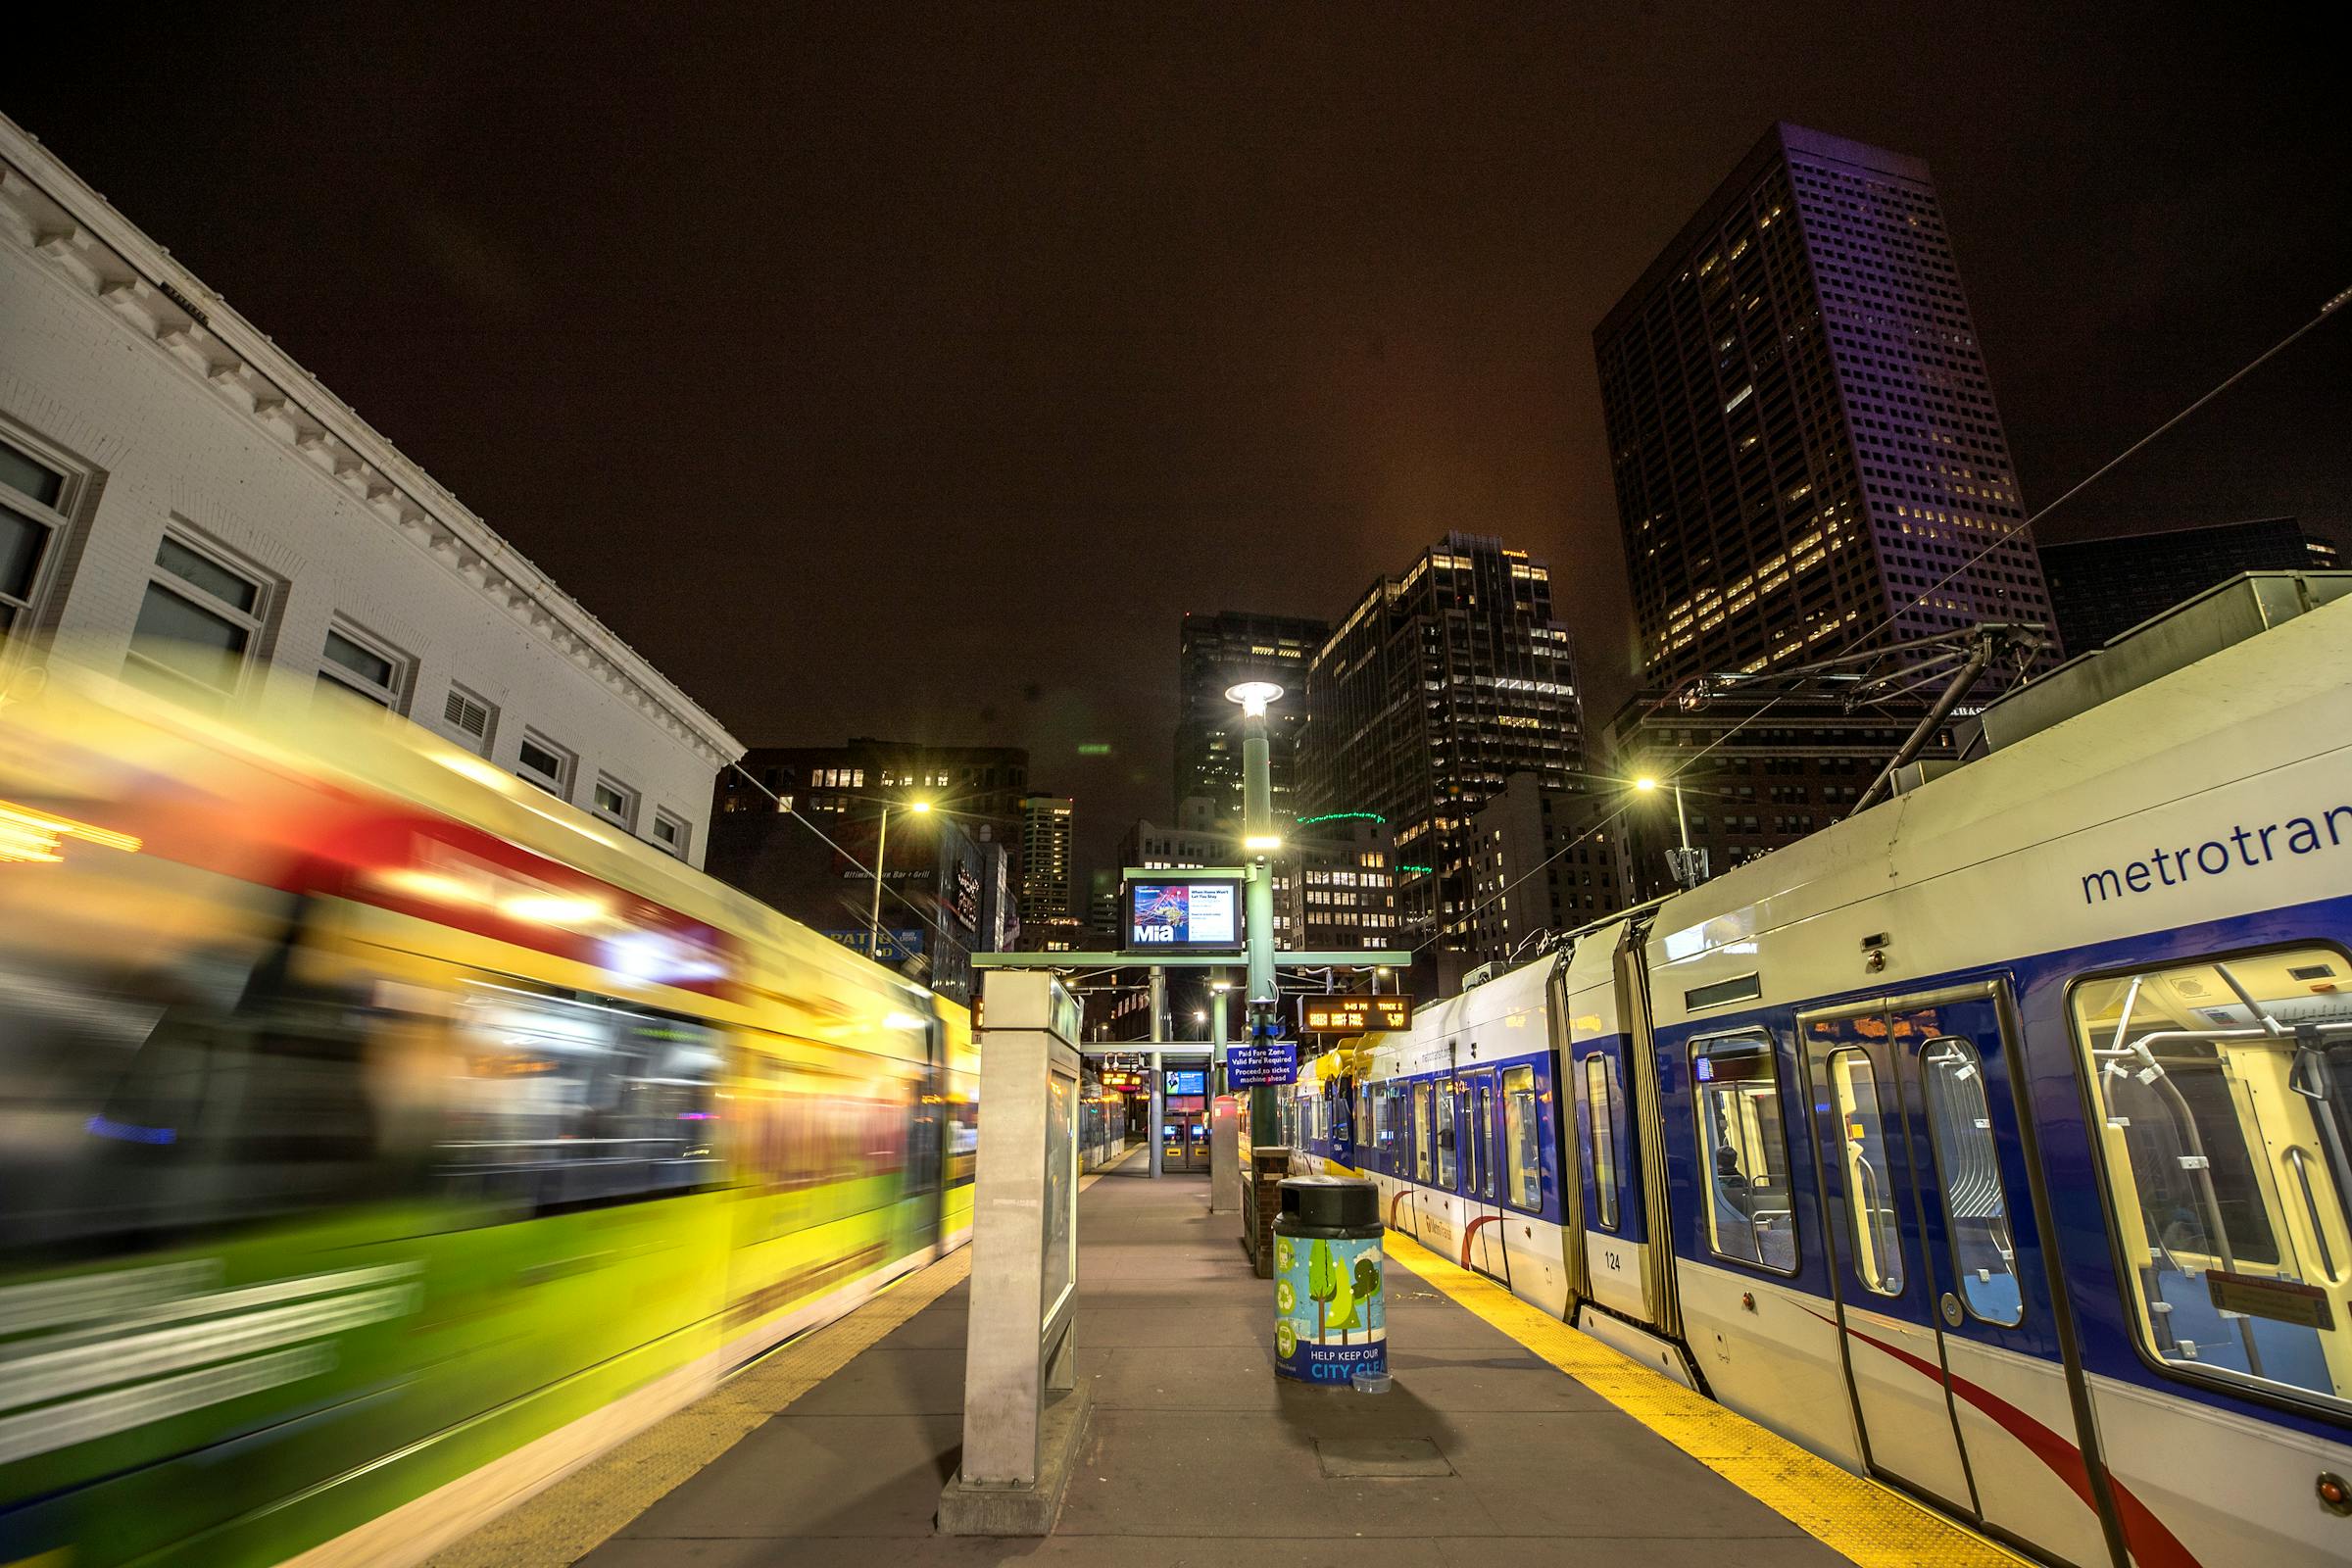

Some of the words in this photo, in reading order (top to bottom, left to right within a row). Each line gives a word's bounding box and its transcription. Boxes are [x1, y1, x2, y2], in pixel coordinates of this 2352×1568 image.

[2082, 806, 2352, 905] metrotran
[830, 933, 893, 945] PATO
[1134, 925, 1174, 942] Mia
[1264, 1056, 1292, 1065] Required
[1604, 1250, 1621, 1272] 124
[1311, 1351, 1335, 1360] HELP
[1339, 1350, 1360, 1360] KEEP
[1363, 1348, 1378, 1359] OUR
[1312, 1363, 1350, 1379] CITY
